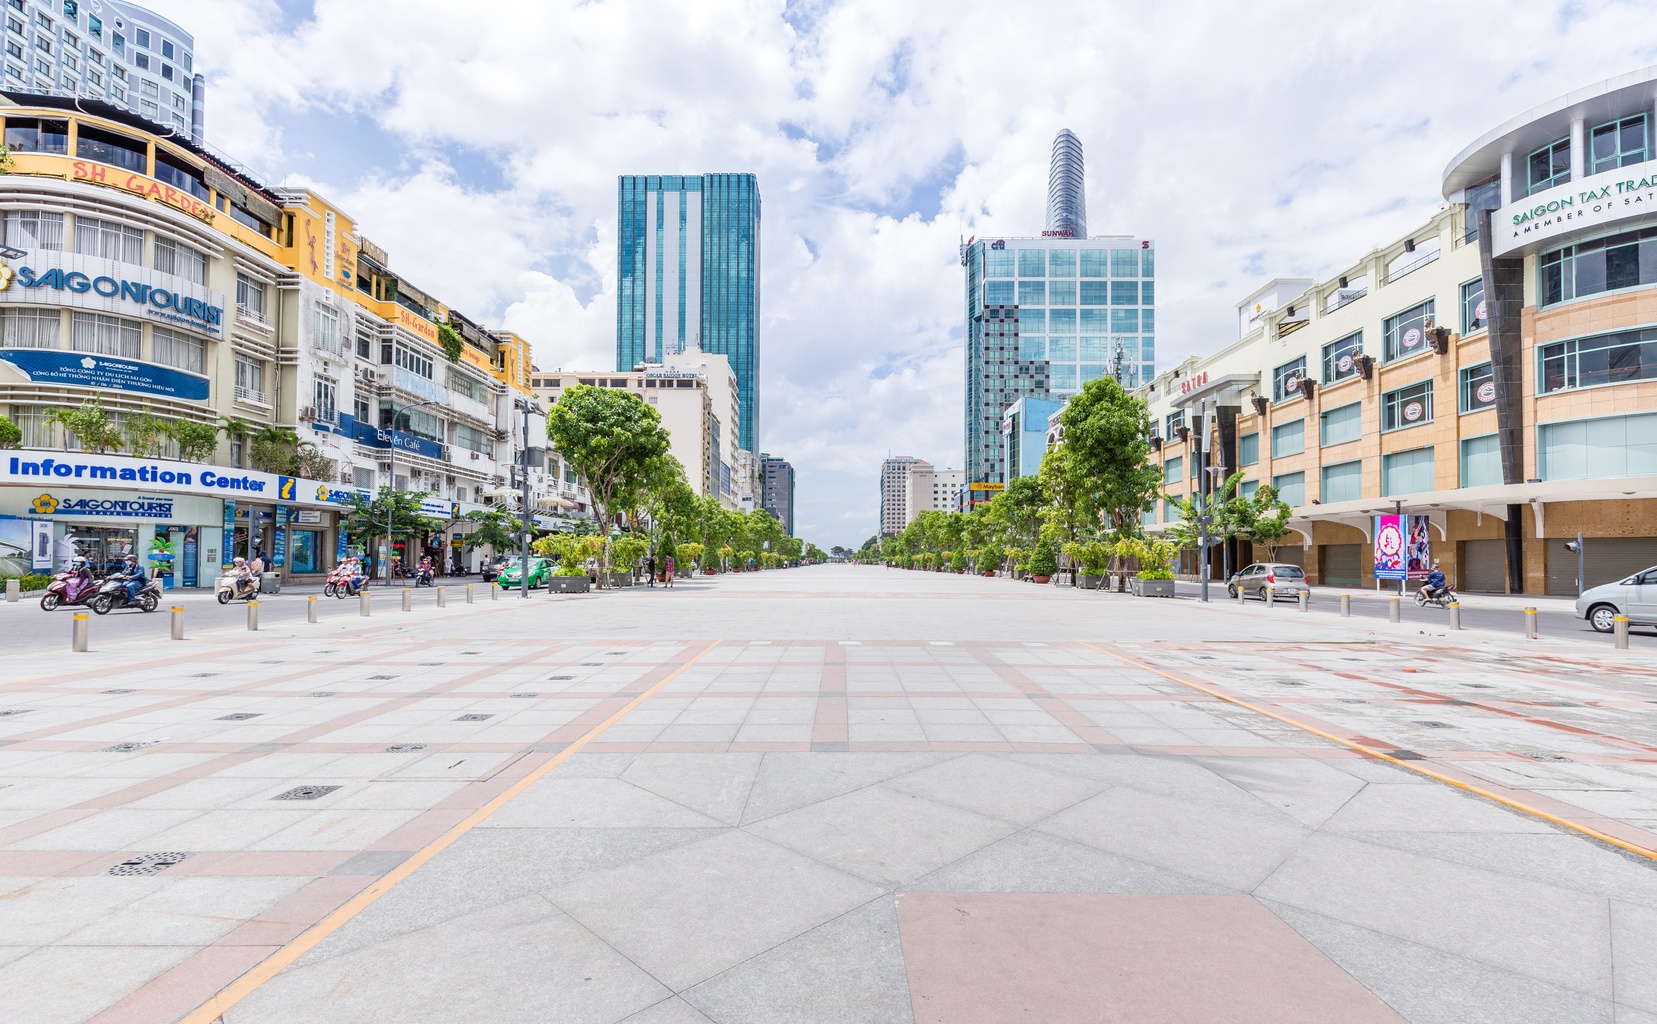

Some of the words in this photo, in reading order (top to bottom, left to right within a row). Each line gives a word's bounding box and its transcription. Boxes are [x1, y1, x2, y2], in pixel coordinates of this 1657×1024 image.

[73, 161, 105, 182] SH
[126, 175, 216, 221] GARDEN
[1513, 196, 1574, 226] SAIGON
[1579, 186, 1612, 204] TAX
[1524, 210, 1584, 234] MEMBER
[1593, 202, 1613, 213] OF
[17, 266, 224, 326] SAIGONTOURIST
[404, 437, 421, 451] Café
[9, 457, 192, 485] Information
[200, 471, 266, 492] Center
[62, 498, 173, 513] SAIGONTOURIST
